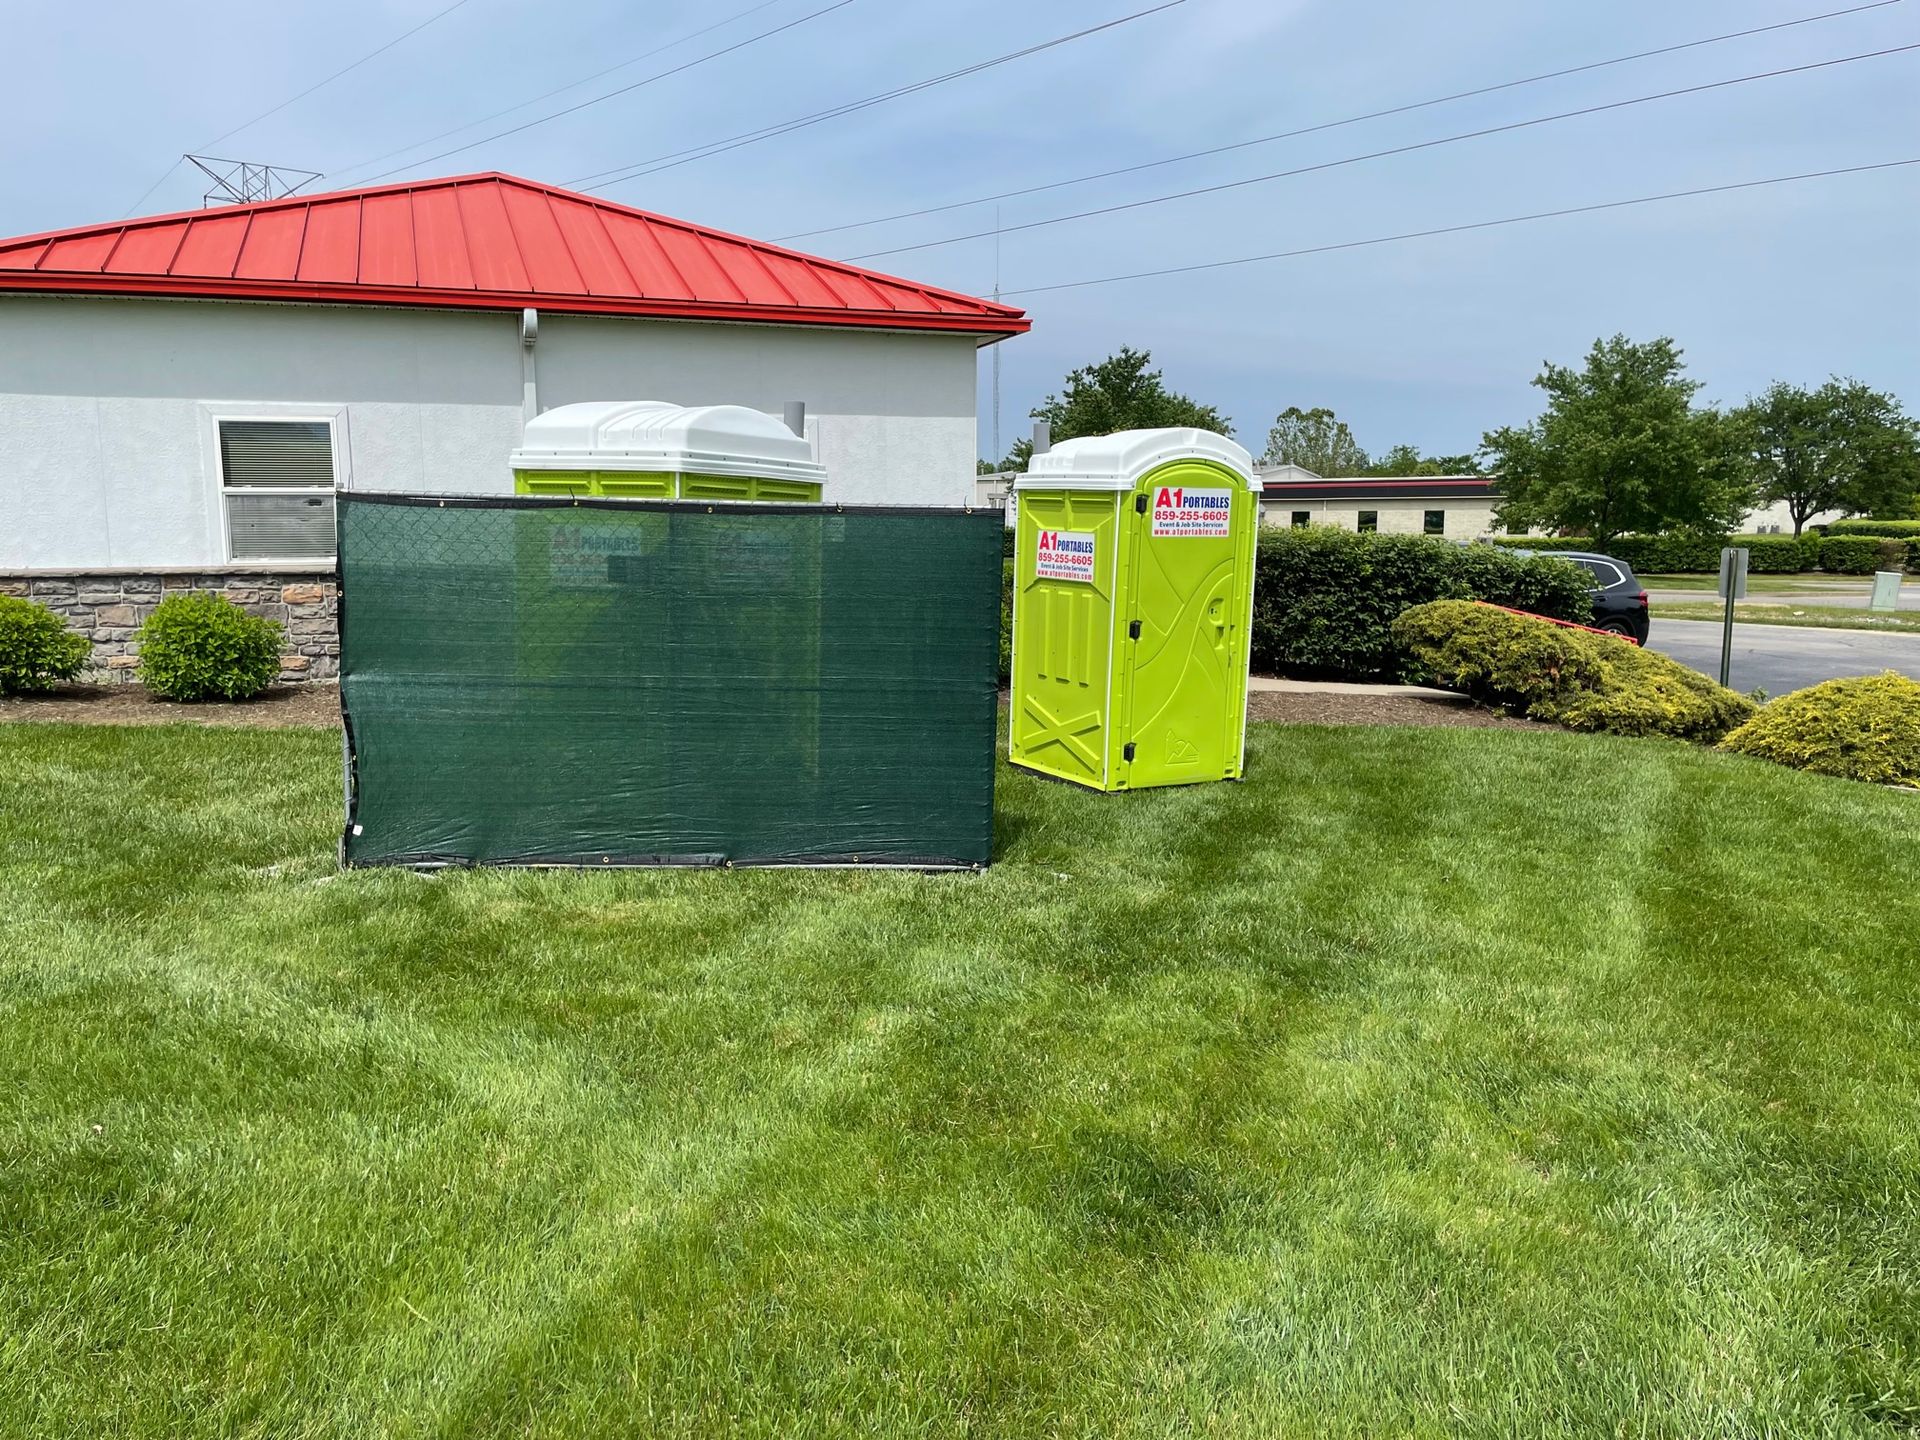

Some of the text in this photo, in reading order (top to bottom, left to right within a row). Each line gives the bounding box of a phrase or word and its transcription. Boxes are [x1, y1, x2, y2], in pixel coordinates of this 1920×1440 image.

[1156, 488, 1230, 509] A1 PORTABLES
[1154, 510, 1228, 521] 859-255-6605
[1039, 531, 1093, 553] A1 PORTABLES
[1038, 552, 1092, 565] 859-255-6605
